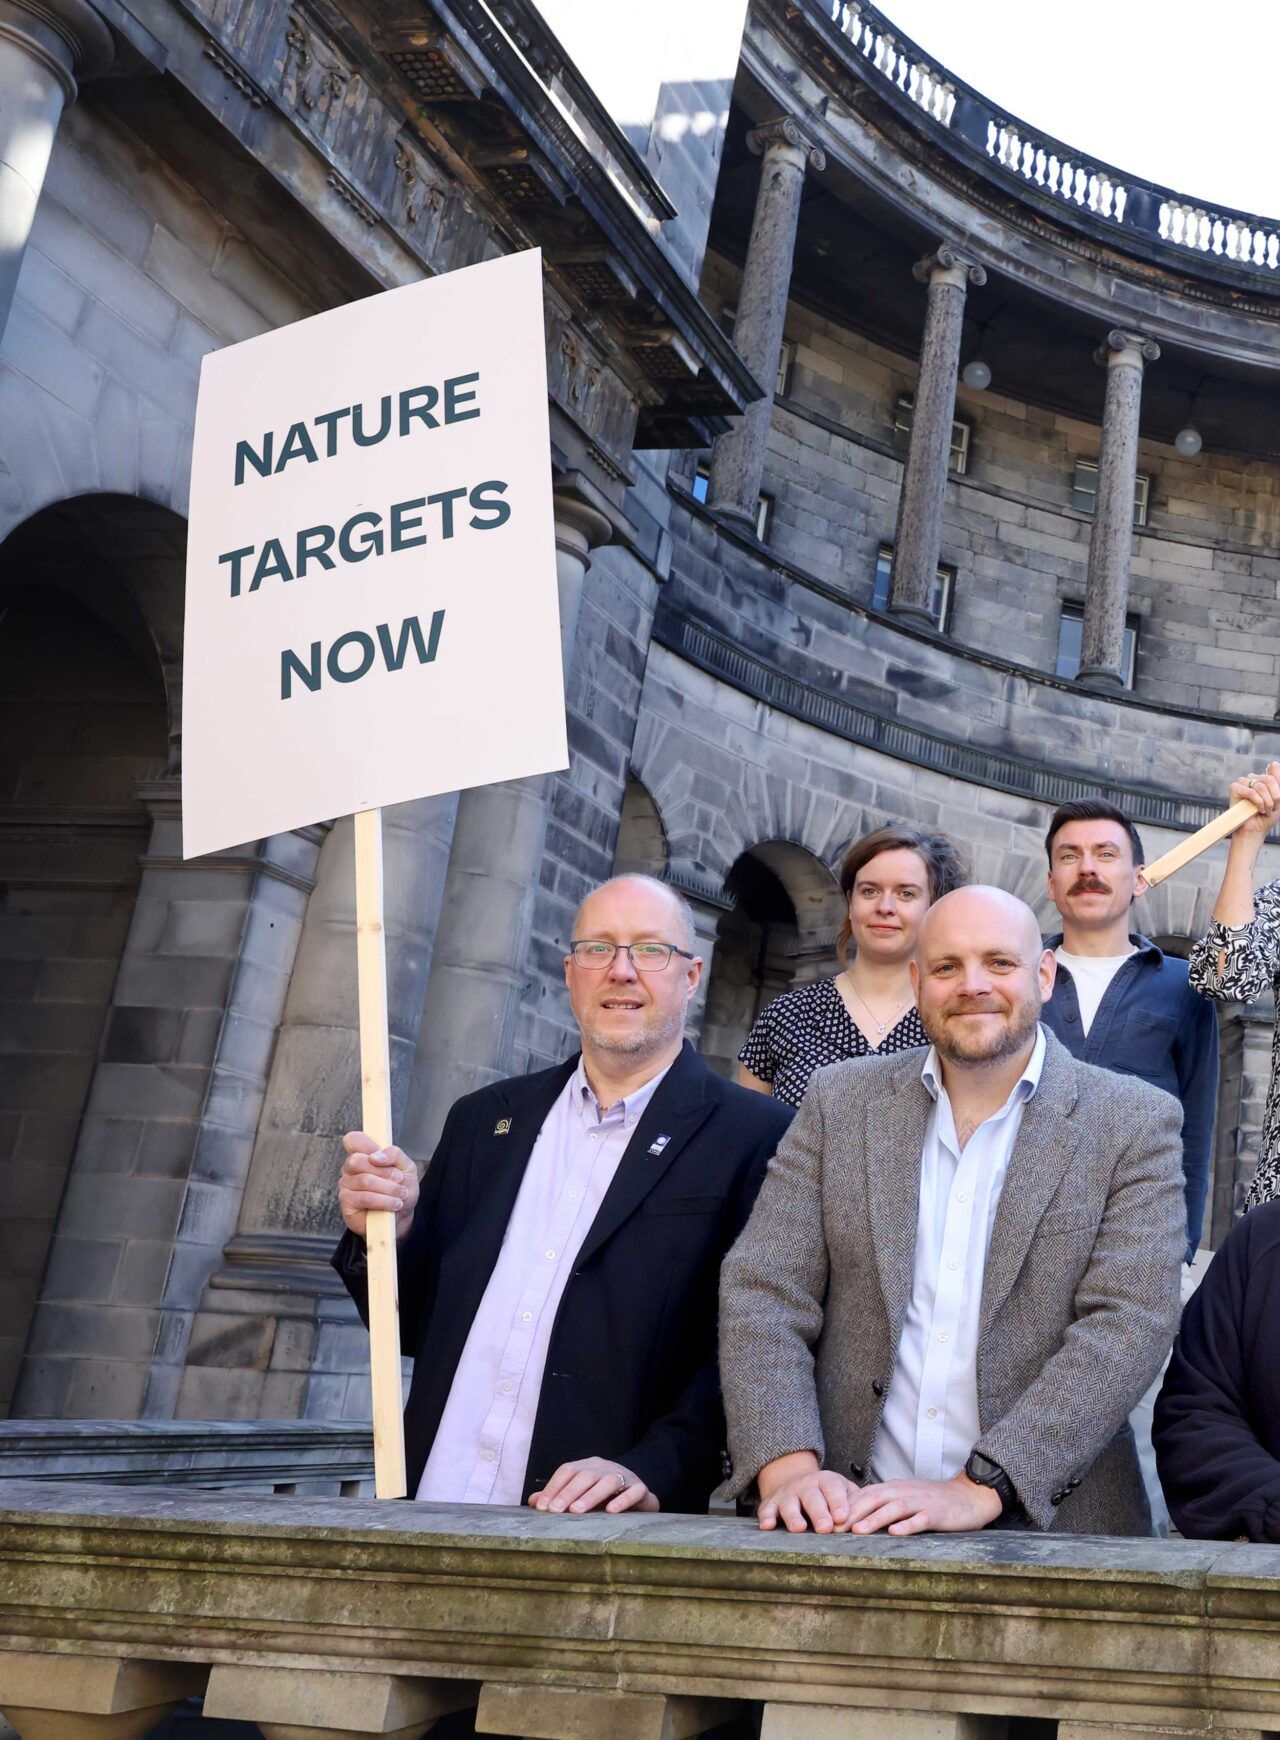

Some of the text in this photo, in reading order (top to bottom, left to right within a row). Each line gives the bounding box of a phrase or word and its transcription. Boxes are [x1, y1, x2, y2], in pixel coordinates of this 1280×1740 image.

[233, 372, 481, 486] NATURE
[218, 480, 511, 598] TARGETS
[281, 609, 446, 700] NOW
